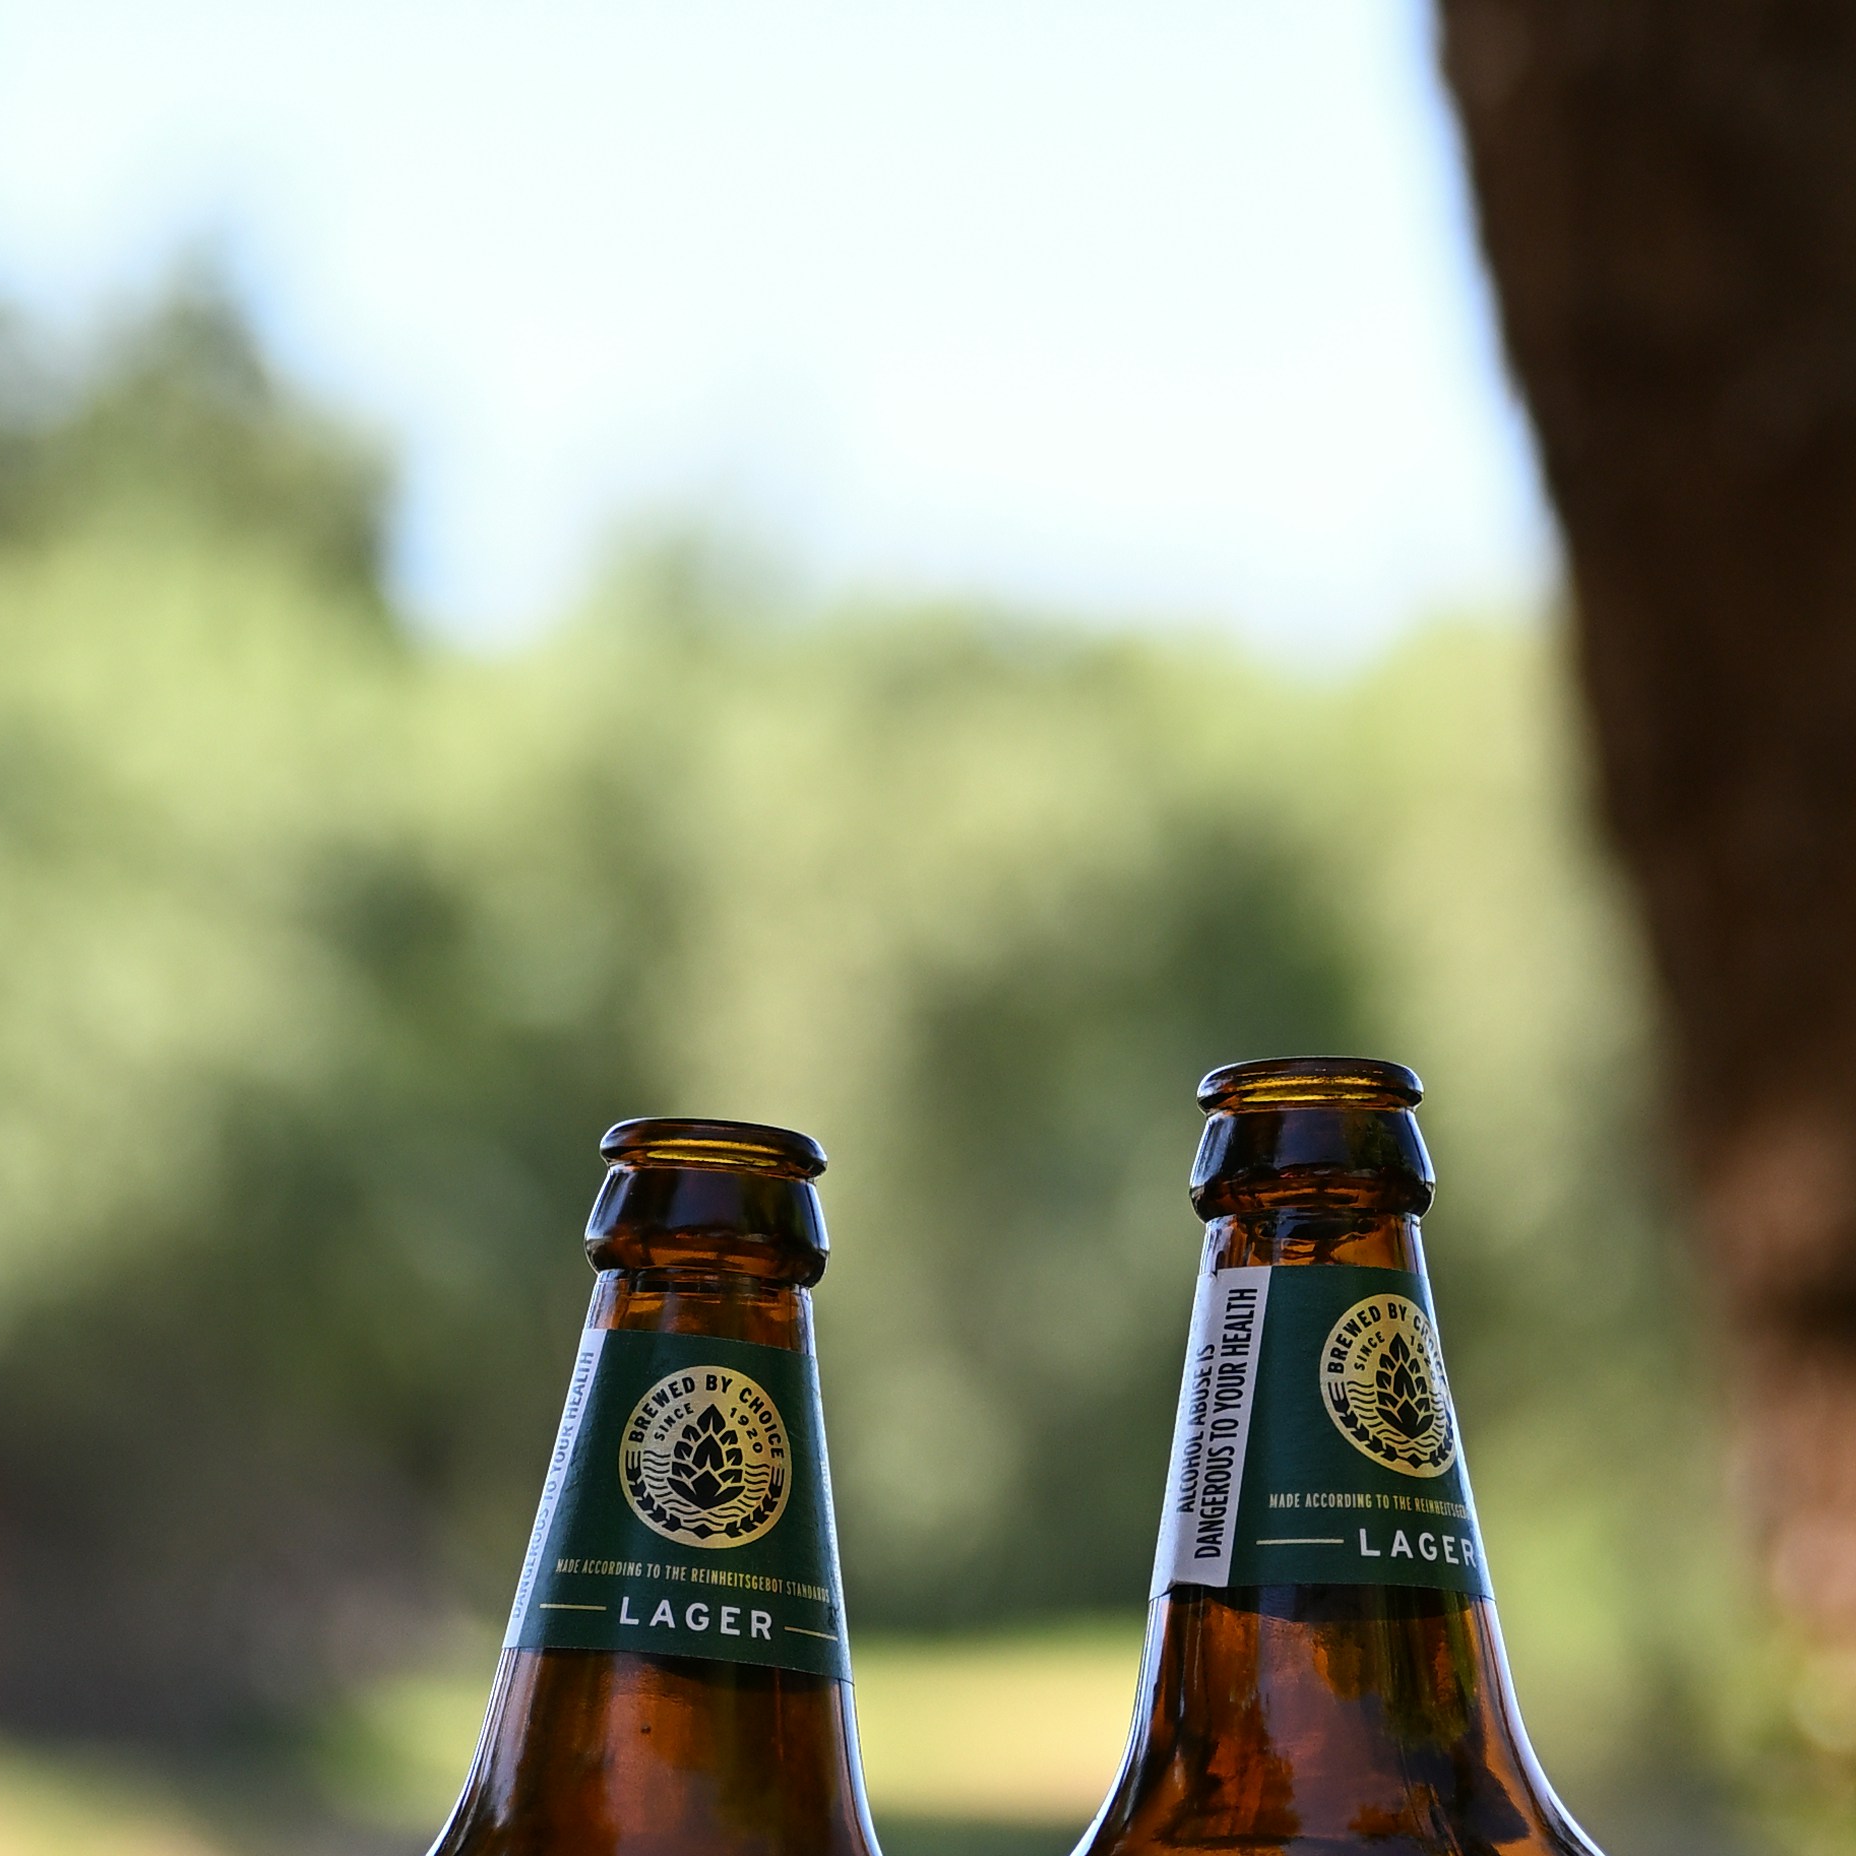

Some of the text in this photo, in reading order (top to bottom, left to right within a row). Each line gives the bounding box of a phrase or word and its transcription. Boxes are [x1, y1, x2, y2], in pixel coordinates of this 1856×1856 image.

[1327, 1305, 1382, 1374] BREWED
[1387, 1302, 1407, 1322] BY
[1354, 1331, 1385, 1371] SINCE
[628, 1374, 784, 1459] BREWED BY CHOICE
[654, 1403, 763, 1454] SINCE 1920
[1176, 1343, 1215, 1513] ALCOHOL ABUSE IS
[1194, 1288, 1258, 1560] DANGEROUS TO YOUR HEALTH
[1269, 1493, 1300, 1509] MADE
[1305, 1493, 1372, 1509] ACCORDING
[1375, 1494, 1390, 1510] TO
[1392, 1495, 1412, 1511] THE
[1359, 1528, 1477, 1568] LAGER
[556, 1558, 830, 1604] MADE ACCORDING TO THE REINHEITSGEBOT STANDARDS
[619, 1596, 772, 1641] LAGER
